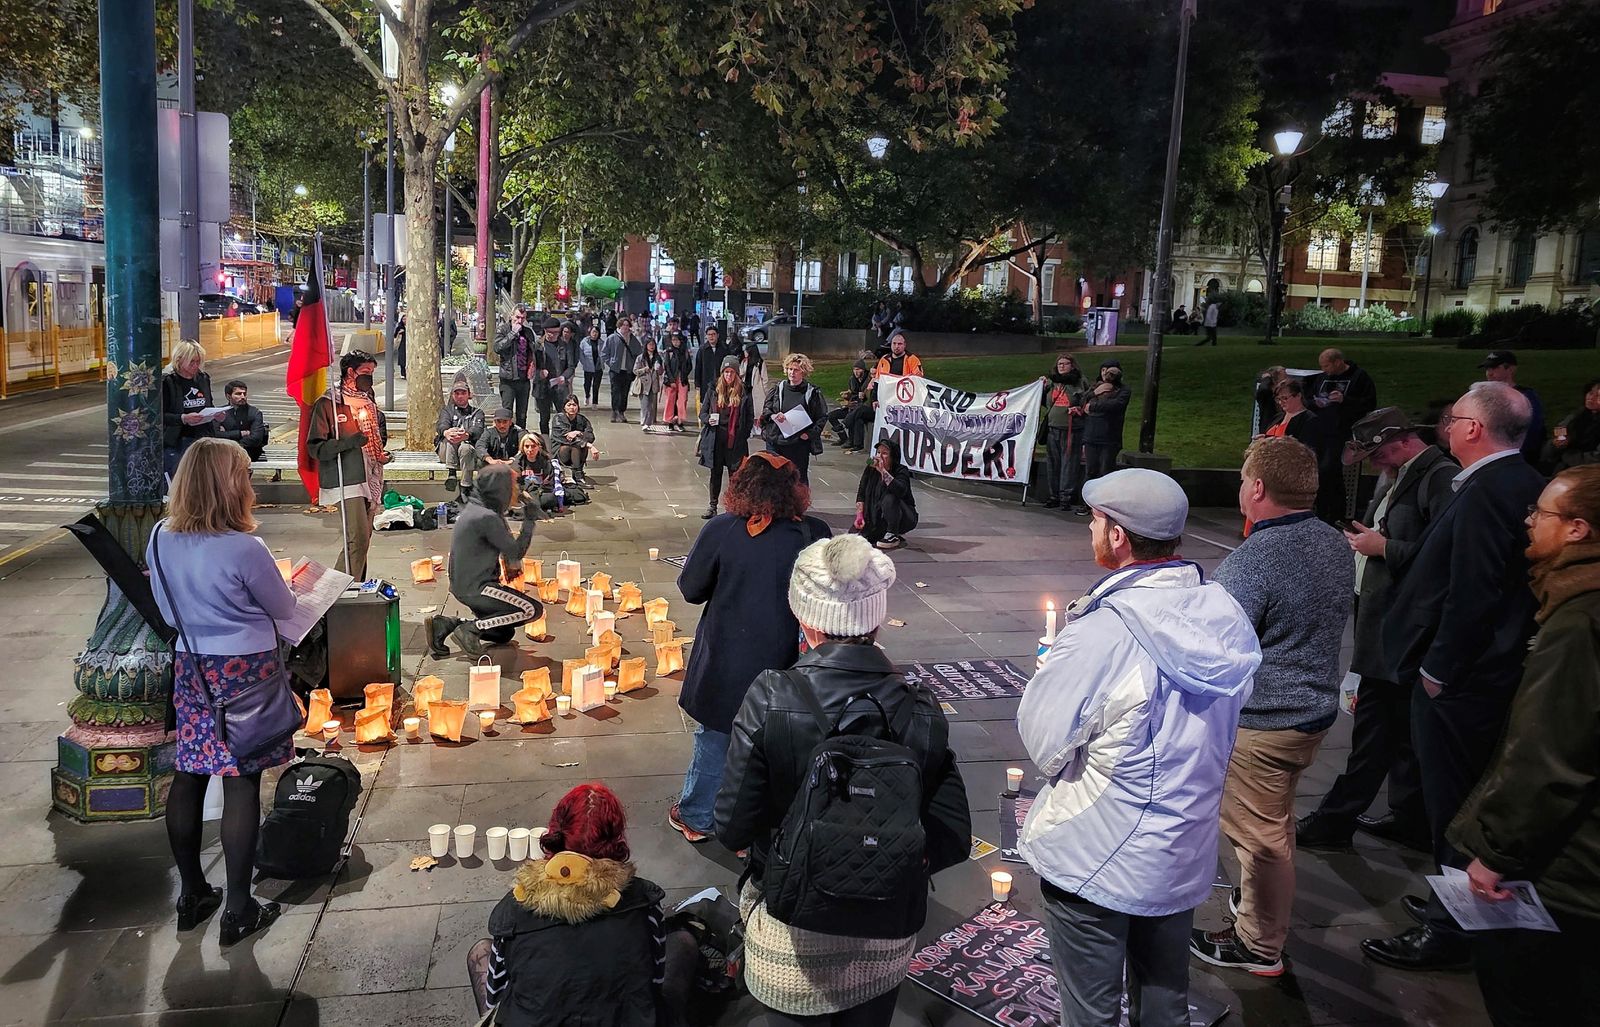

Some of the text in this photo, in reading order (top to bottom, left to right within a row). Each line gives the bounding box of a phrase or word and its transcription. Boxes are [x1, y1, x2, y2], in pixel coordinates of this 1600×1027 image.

[923, 384, 976, 413] END
[885, 405, 1026, 433] STATE SANCTIONED
[933, 664, 987, 697] EXECUTED
[288, 793, 317, 802] adidas
[909, 902, 1018, 976] NORASHAREE
[934, 934, 1005, 978] bin Gous
[951, 927, 1050, 998] KALWANT
[992, 964, 1057, 1000] Singh
